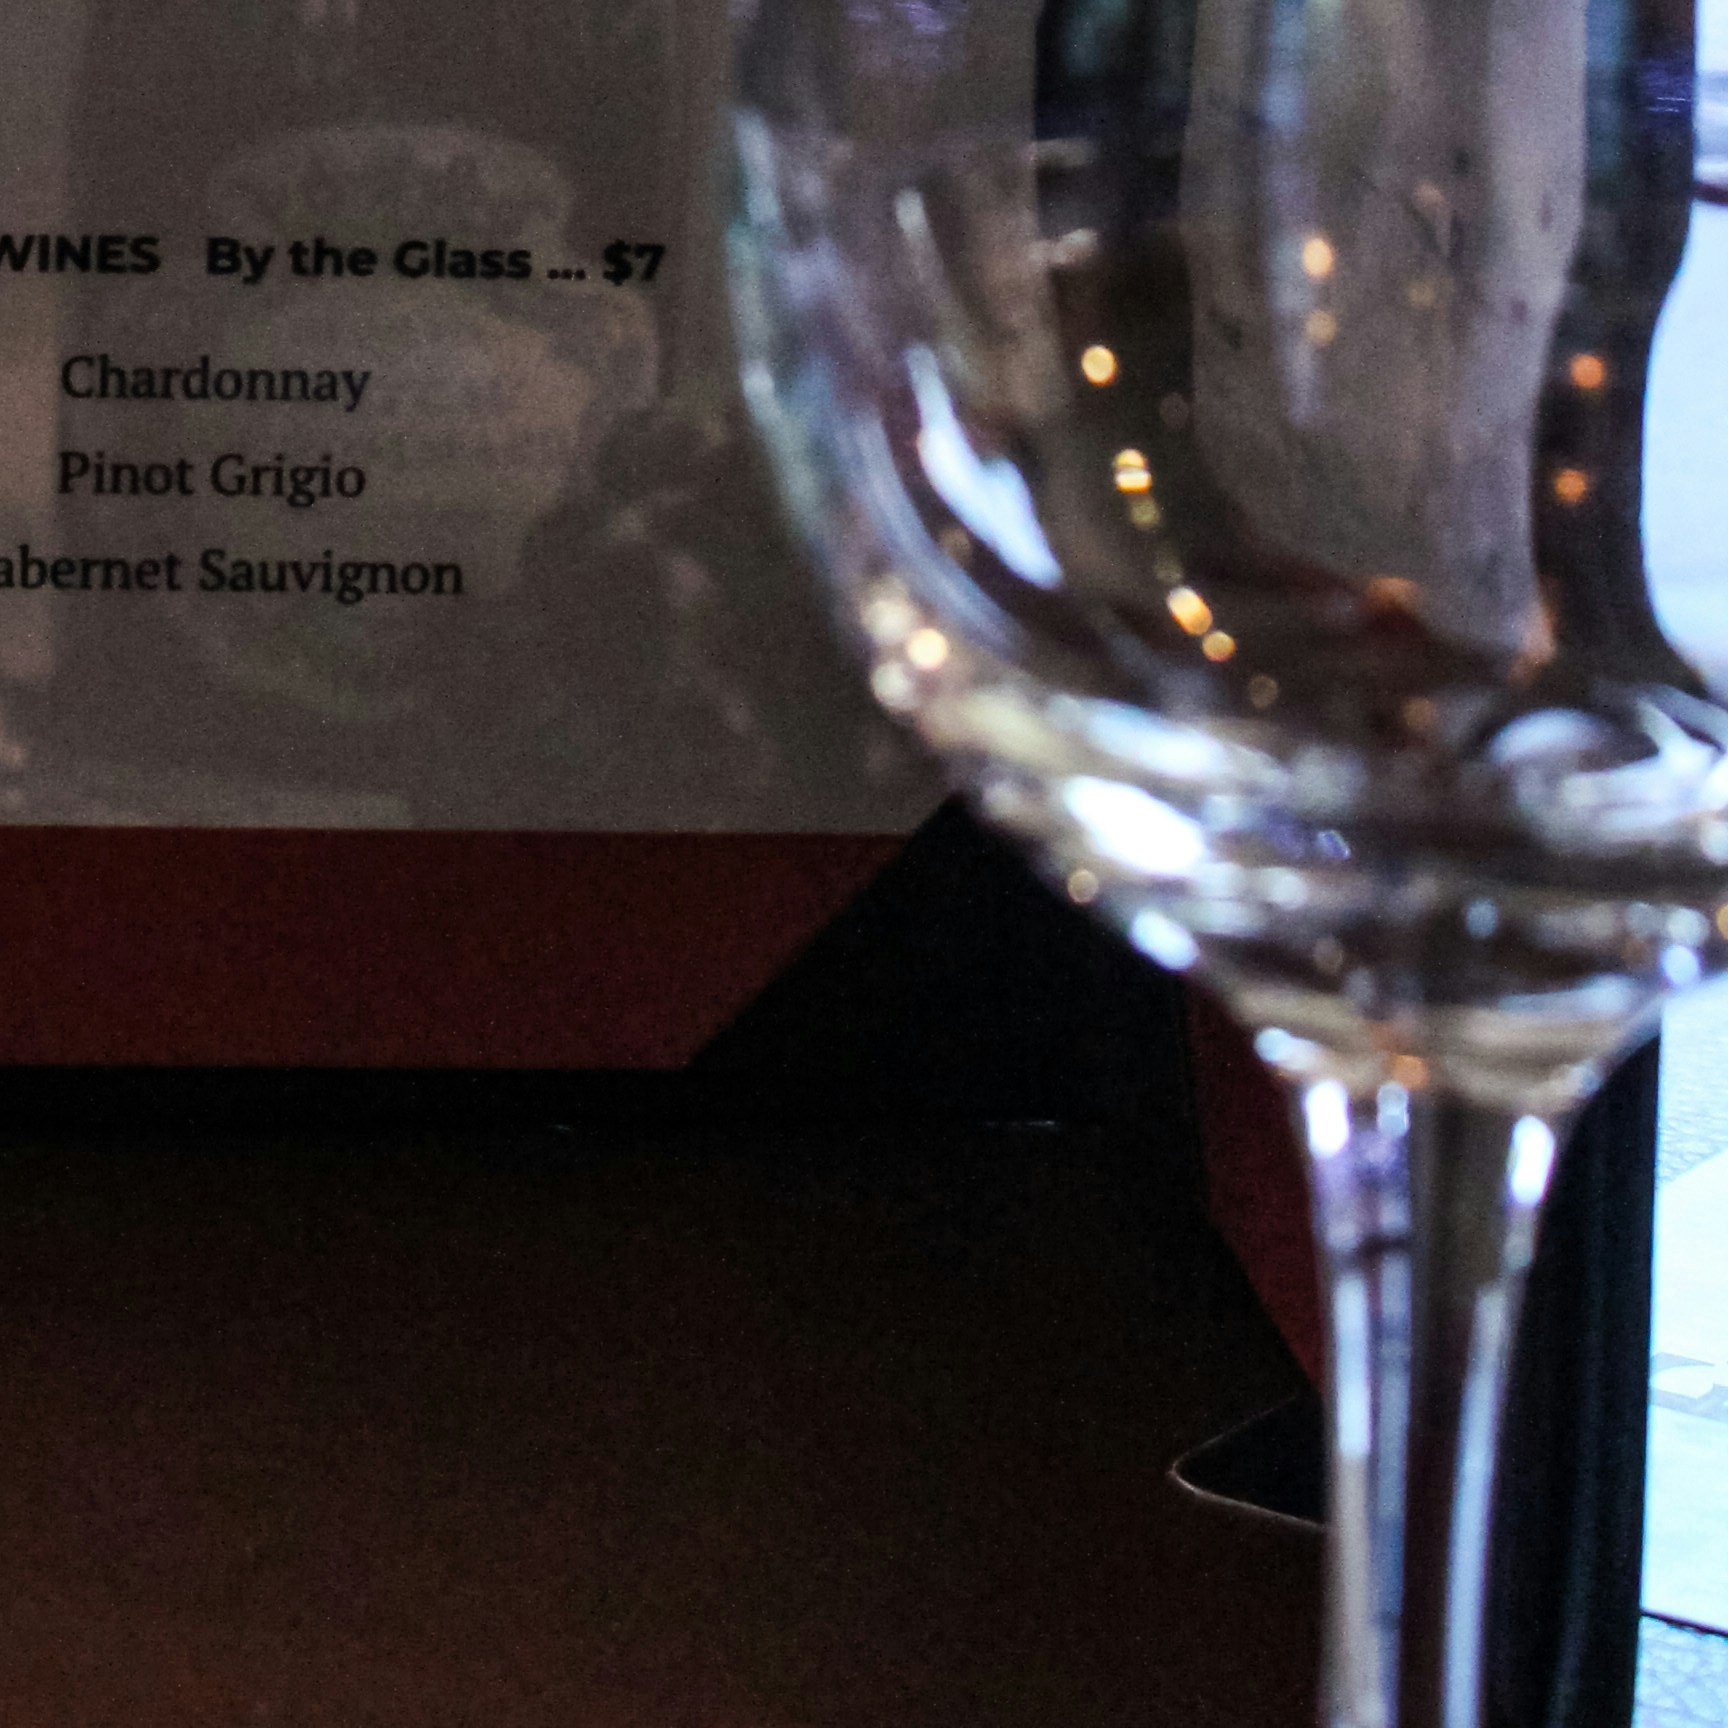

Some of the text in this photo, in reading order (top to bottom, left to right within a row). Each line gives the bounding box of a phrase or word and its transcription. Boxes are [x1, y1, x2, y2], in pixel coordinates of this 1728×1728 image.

[206, 236, 273, 285] By
[287, 236, 378, 277] the
[392, 238, 532, 281] Glass
[602, 238, 666, 285] $7
